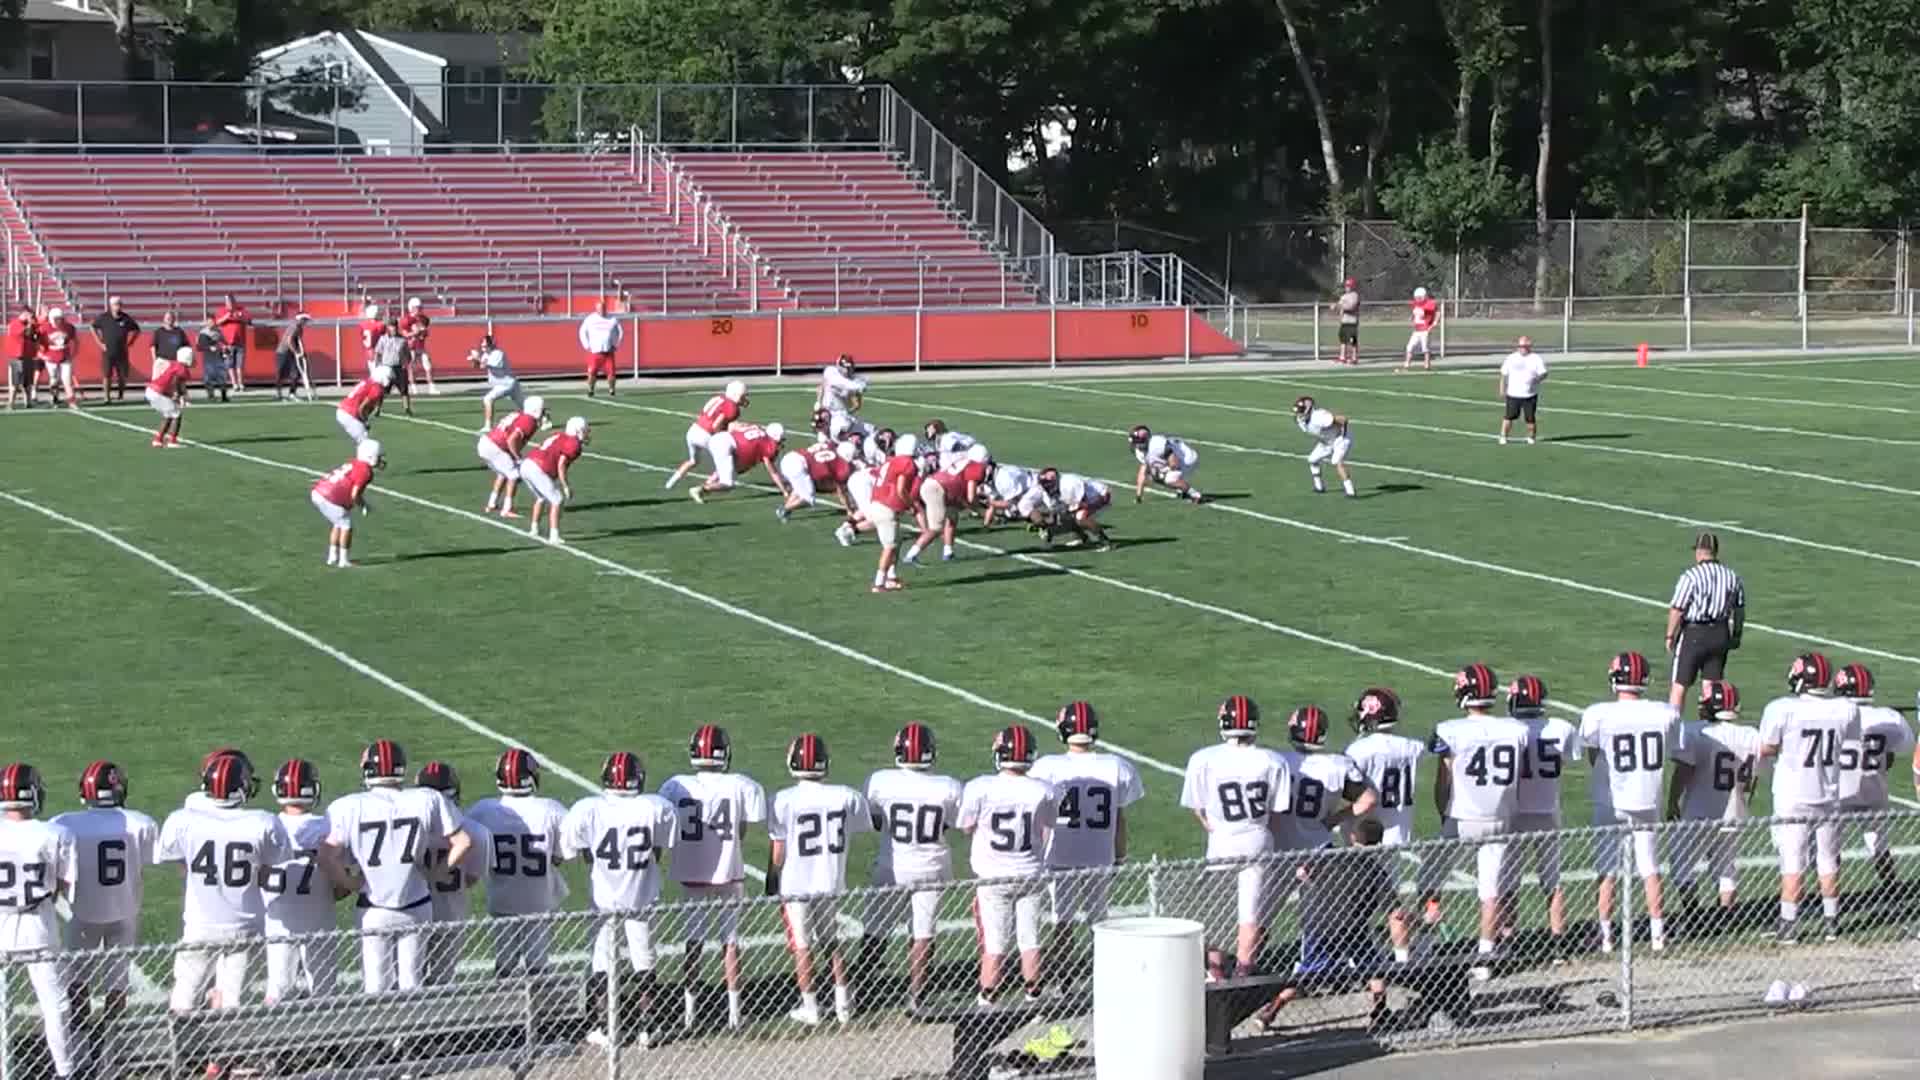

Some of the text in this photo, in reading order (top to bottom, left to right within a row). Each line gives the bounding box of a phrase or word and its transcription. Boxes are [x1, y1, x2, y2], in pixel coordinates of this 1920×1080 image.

[711, 319, 733, 335] 20
[1131, 314, 1149, 328] 10
[1465, 745, 1515, 786] 49
[1612, 731, 1663, 772] 80
[1802, 728, 1836, 768] 71
[1381, 766, 1413, 808] 81
[1713, 752, 1754, 792] 64
[1058, 786, 1111, 829] 43
[1218, 781, 1269, 822] 82
[1281, 774, 1324, 818] 8
[678, 797, 733, 841] 34
[797, 810, 847, 857] 23
[889, 803, 943, 844] 60
[990, 812, 1033, 852] 51
[359, 816, 421, 867] 77
[493, 834, 547, 877] 65
[596, 826, 651, 870] 42
[0, 861, 46, 906] 22
[98, 840, 125, 886] 6
[191, 840, 253, 887] 46
